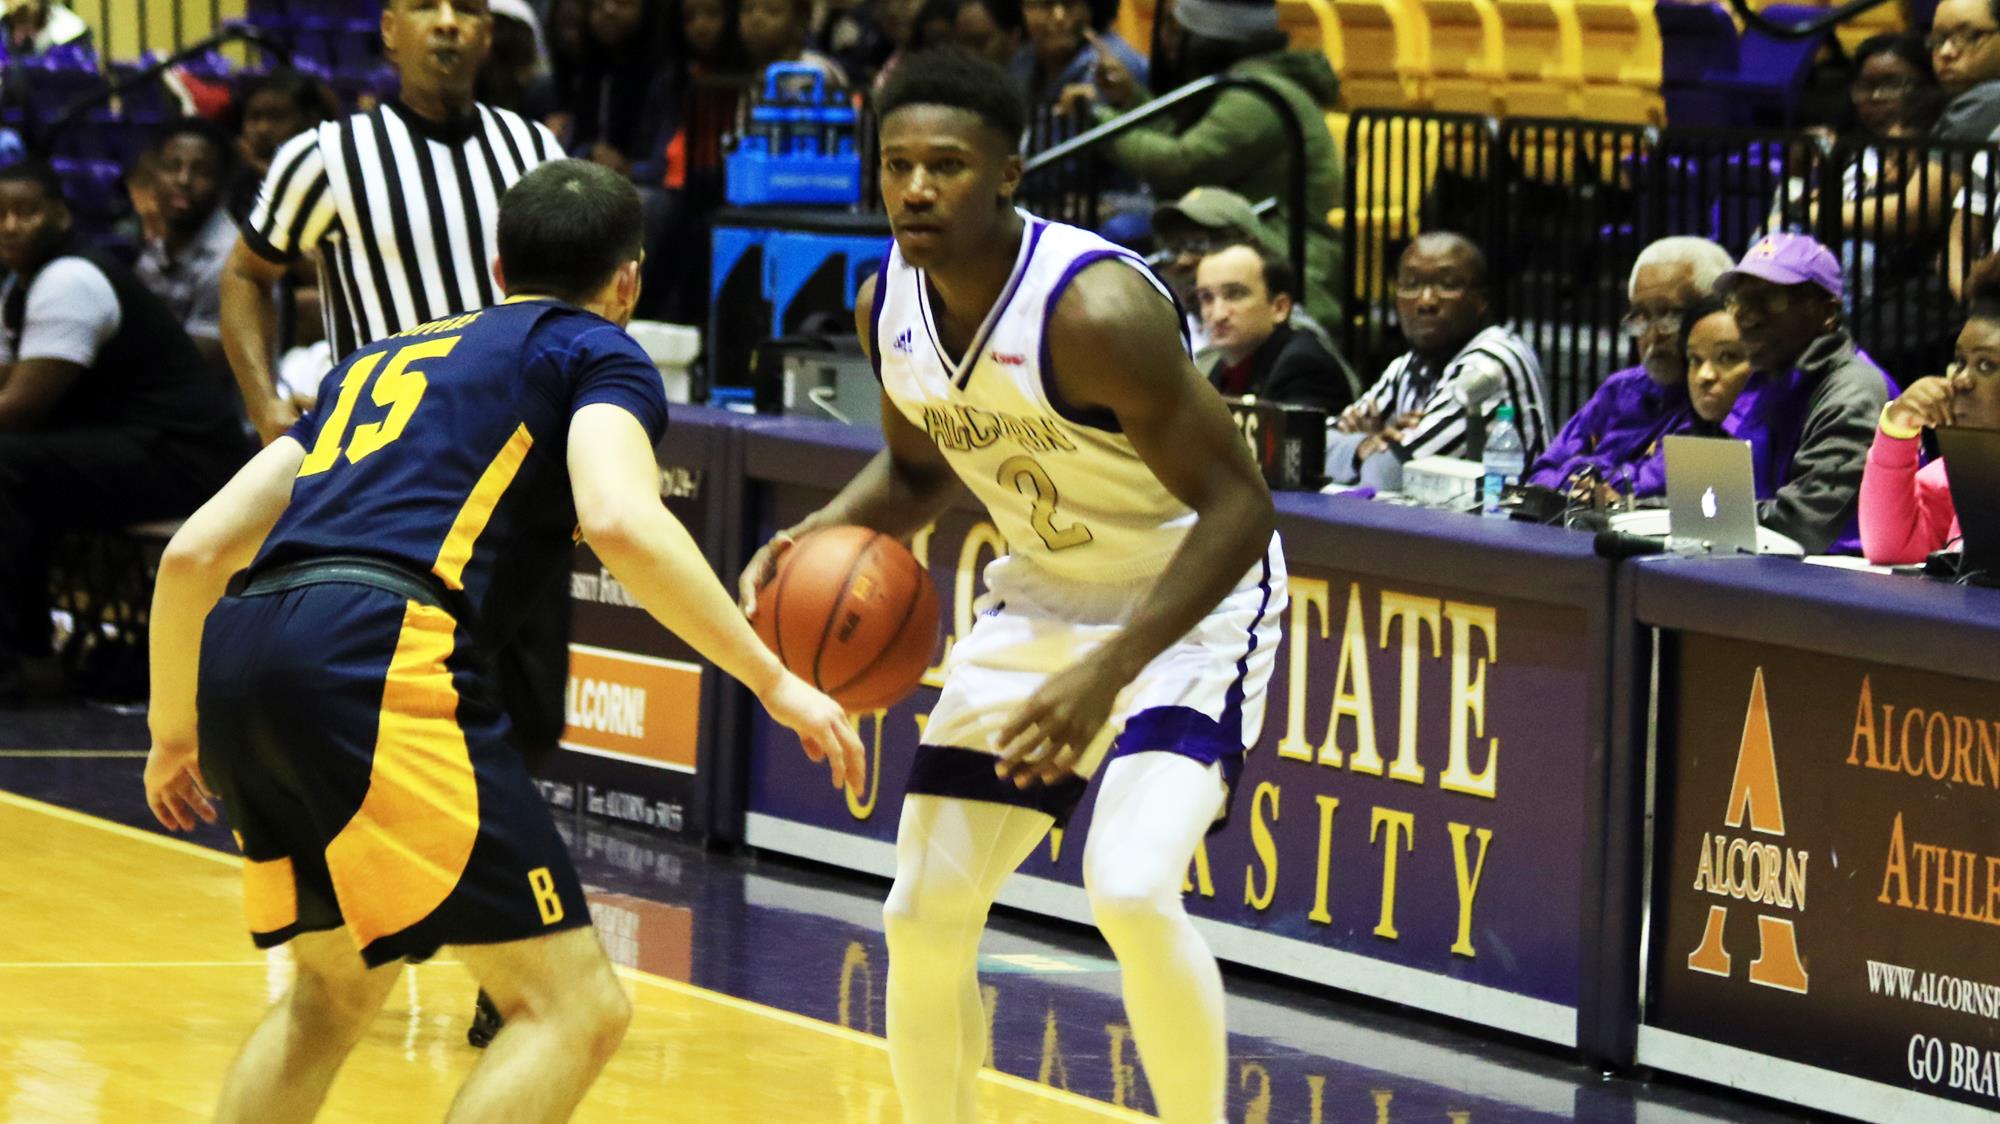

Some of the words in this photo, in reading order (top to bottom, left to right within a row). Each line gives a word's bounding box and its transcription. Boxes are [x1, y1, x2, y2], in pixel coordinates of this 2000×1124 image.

[296, 335, 462, 478] 15
[997, 455, 1093, 552] 2
[565, 676, 646, 740] LCORN!
[1277, 576, 1498, 798] TATE
[1846, 674, 2000, 790] ALCORN
[527, 866, 565, 926] B
[1693, 831, 1809, 912] ALCORN
[1877, 811, 2000, 926] ATHLE
[1907, 1033, 1945, 1084] GO
